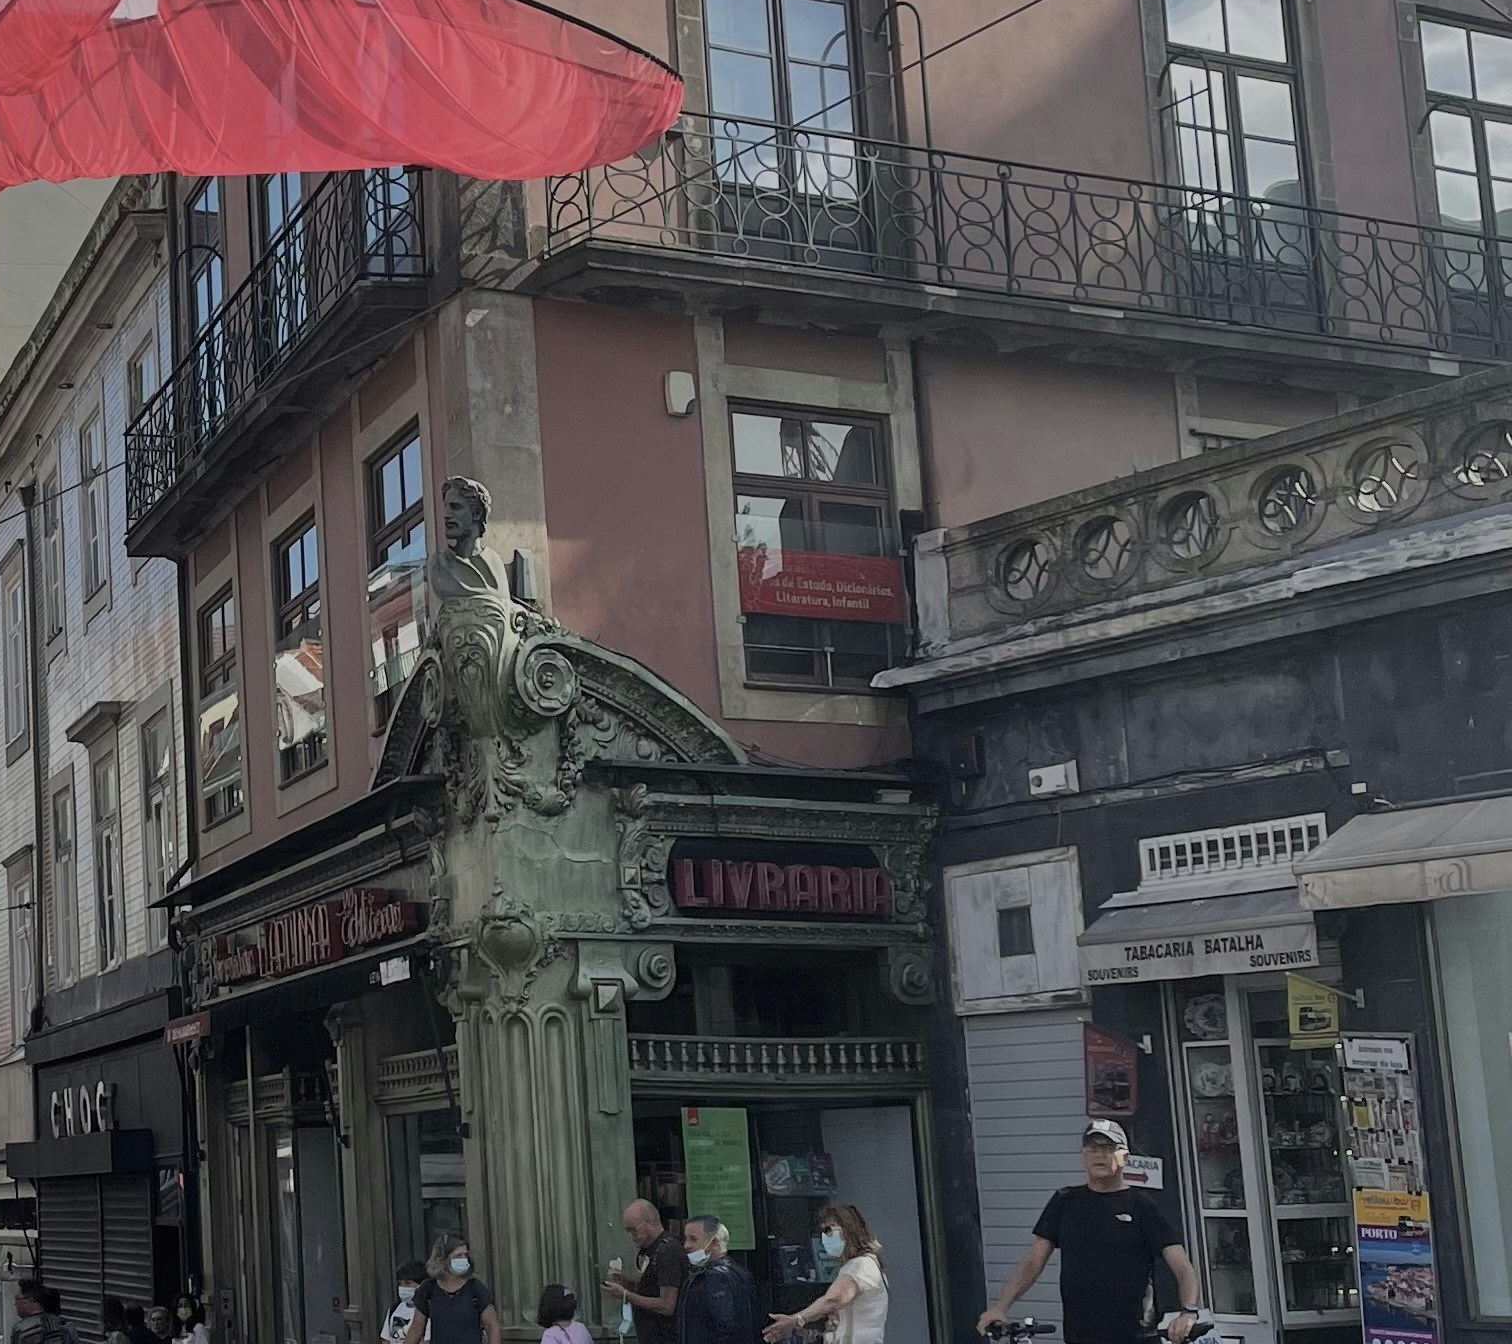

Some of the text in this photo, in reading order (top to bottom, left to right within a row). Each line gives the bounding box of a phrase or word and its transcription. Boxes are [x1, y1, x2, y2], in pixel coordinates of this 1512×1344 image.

[676, 858, 896, 917] LIVRARIA
[1124, 934, 1264, 961] TABACARIA BATALHA
[1250, 950, 1311, 968] SOUVENIRS
[1087, 965, 1139, 981] SOUVENIRS
[1360, 1227, 1398, 1240] PORTO
